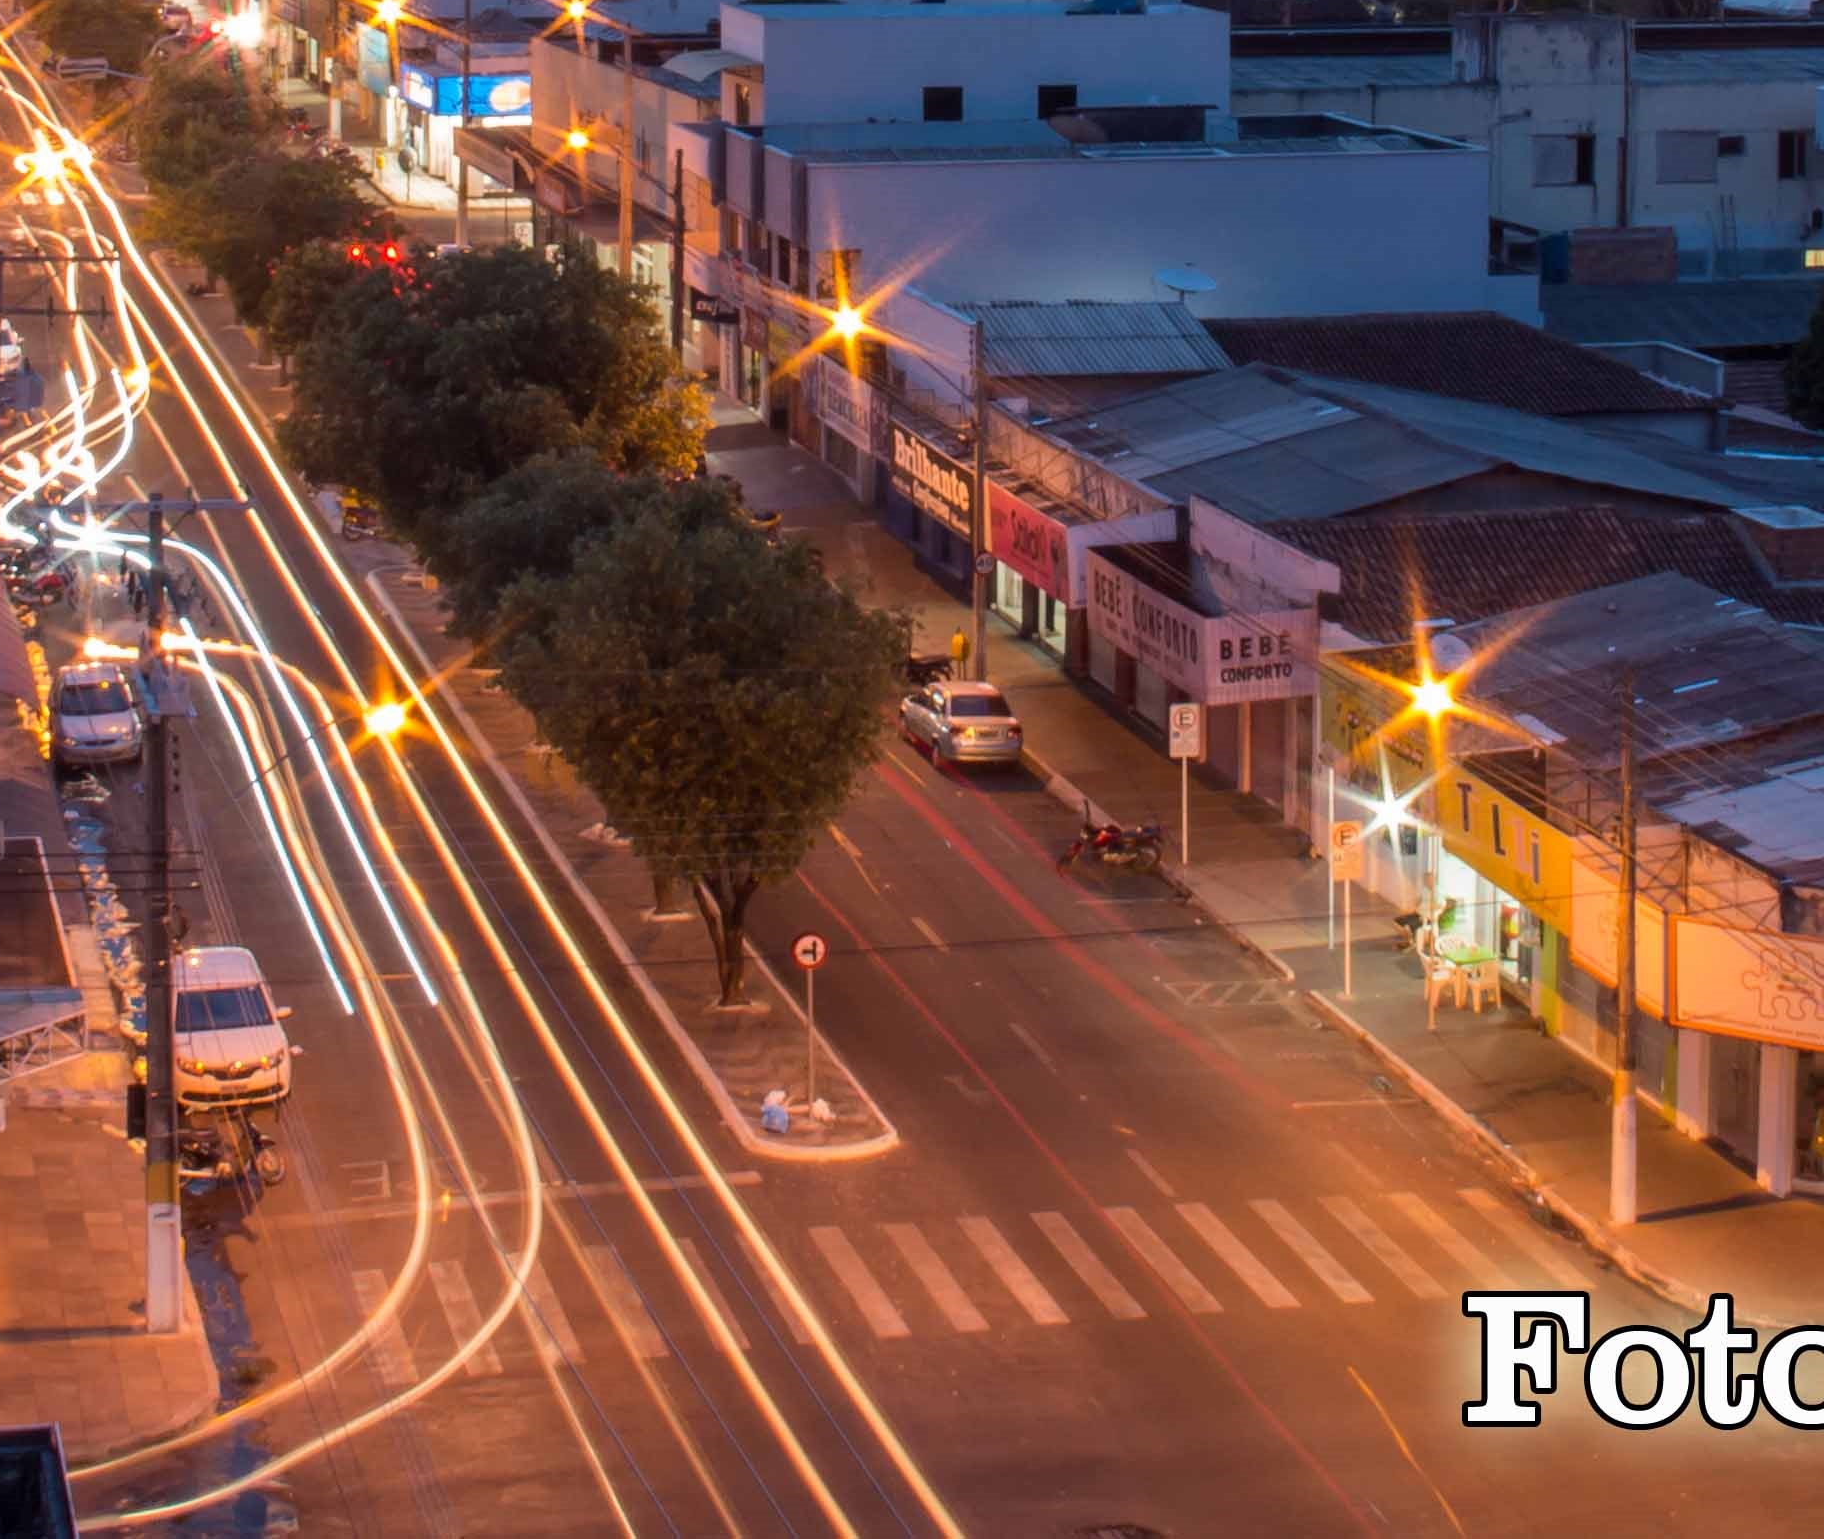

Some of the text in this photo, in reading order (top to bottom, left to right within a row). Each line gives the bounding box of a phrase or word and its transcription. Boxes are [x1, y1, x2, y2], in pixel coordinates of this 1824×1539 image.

[894, 428, 969, 512] Brilhante
[1132, 593, 1198, 666] CONFORTO
[1220, 662, 1293, 683] CONFORTO
